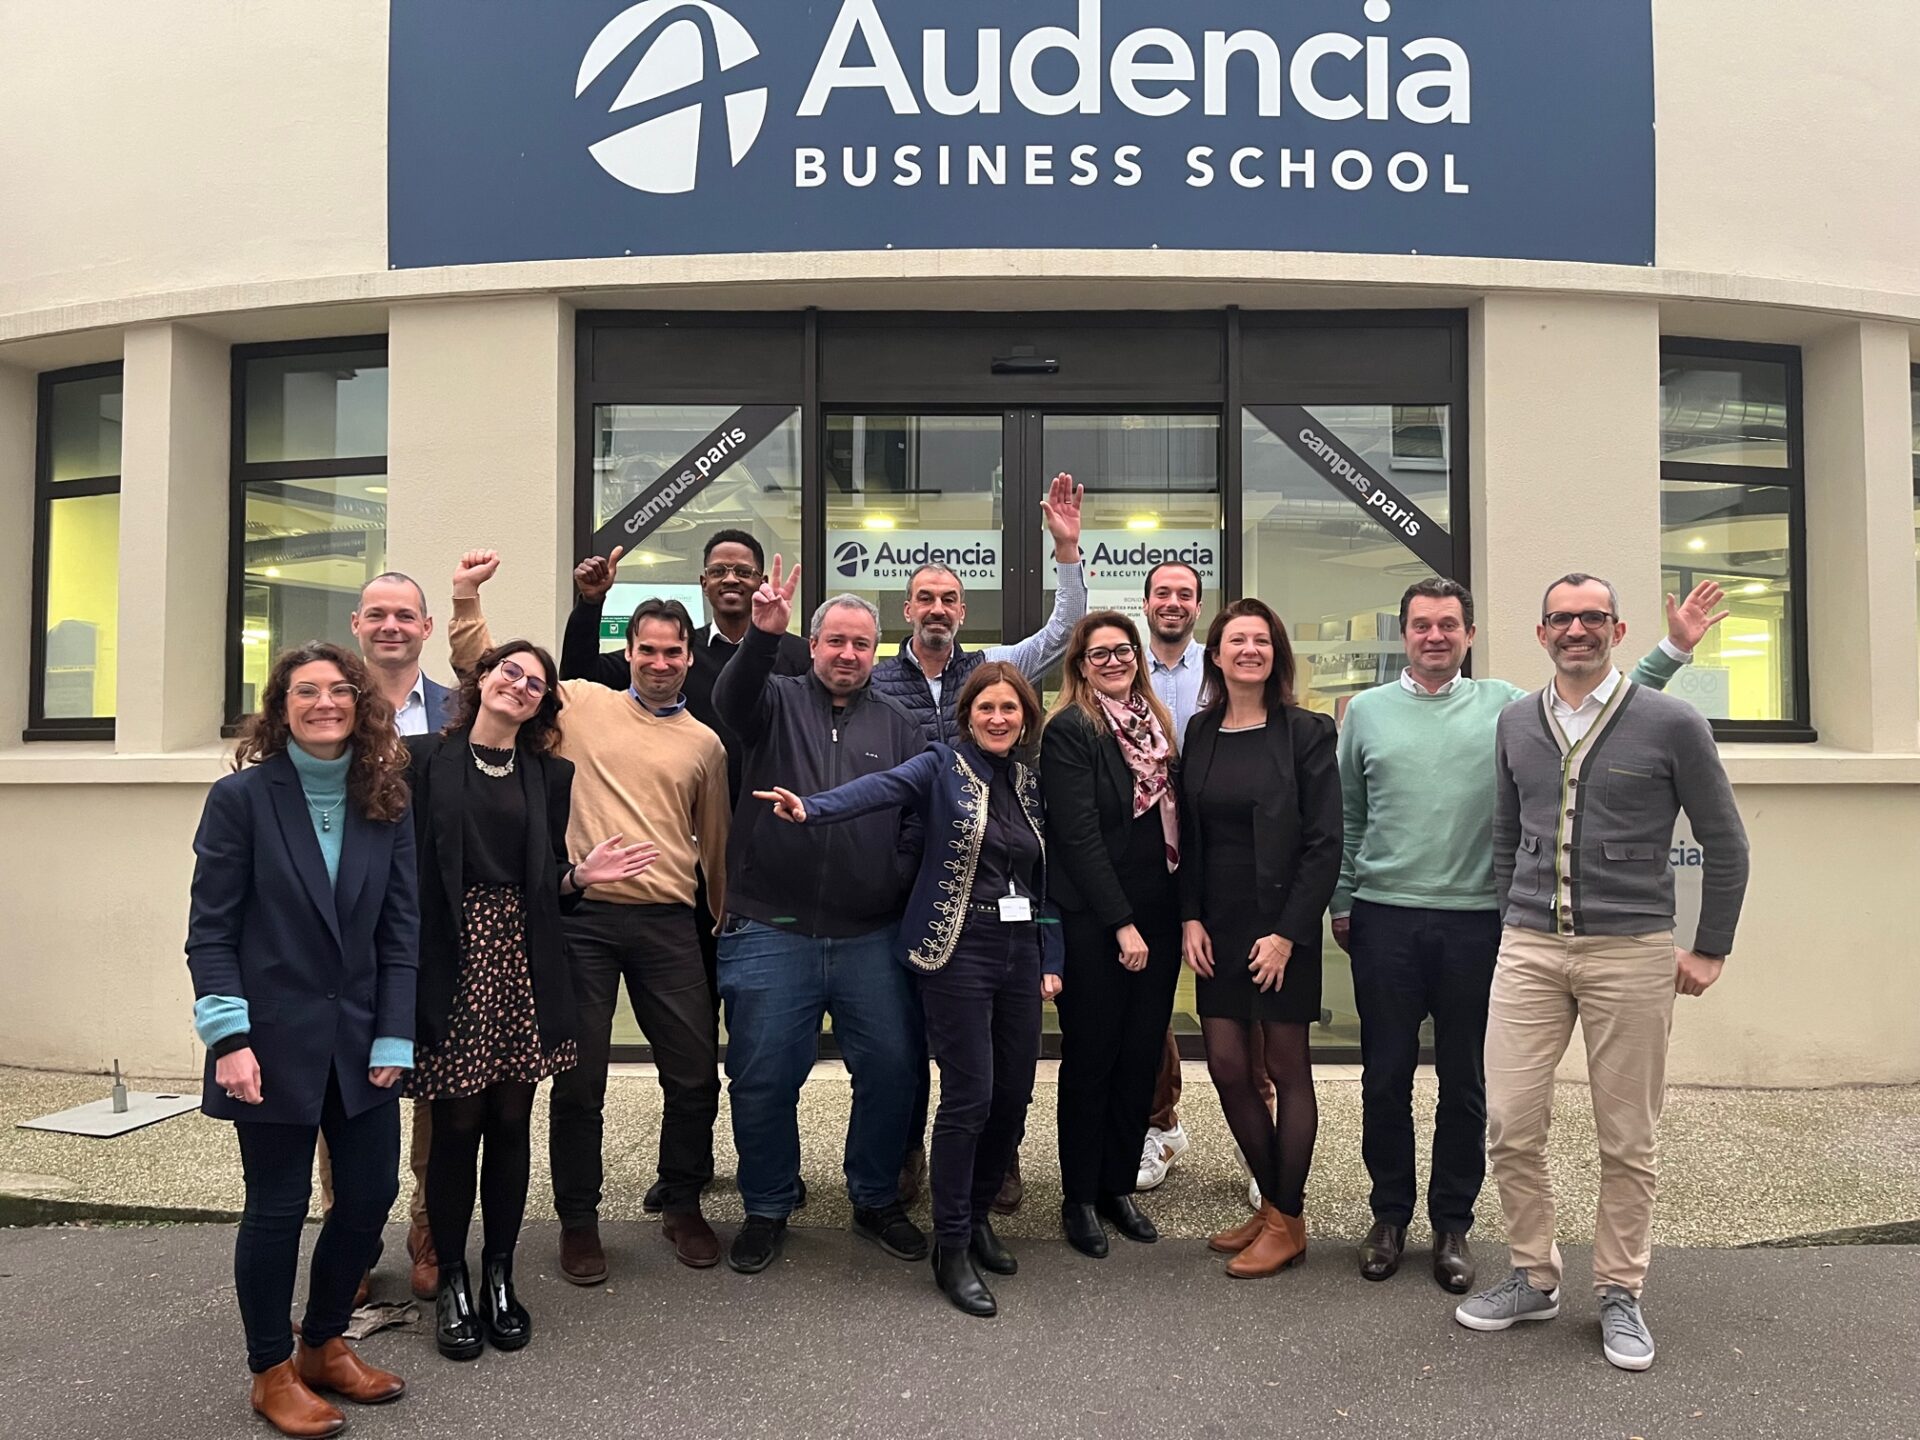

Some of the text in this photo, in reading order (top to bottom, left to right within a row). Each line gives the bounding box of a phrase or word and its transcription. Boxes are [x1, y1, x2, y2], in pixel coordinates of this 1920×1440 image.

[796, 0, 1471, 123] Audencia
[795, 144, 1469, 194] BUSINESS SCHOOL
[623, 426, 748, 534] campus_paris
[1299, 428, 1421, 537] campus_paris
[873, 569, 995, 577] BUSIN HOOL
[874, 541, 996, 565] Audencia
[1091, 541, 1213, 565] Audencia
